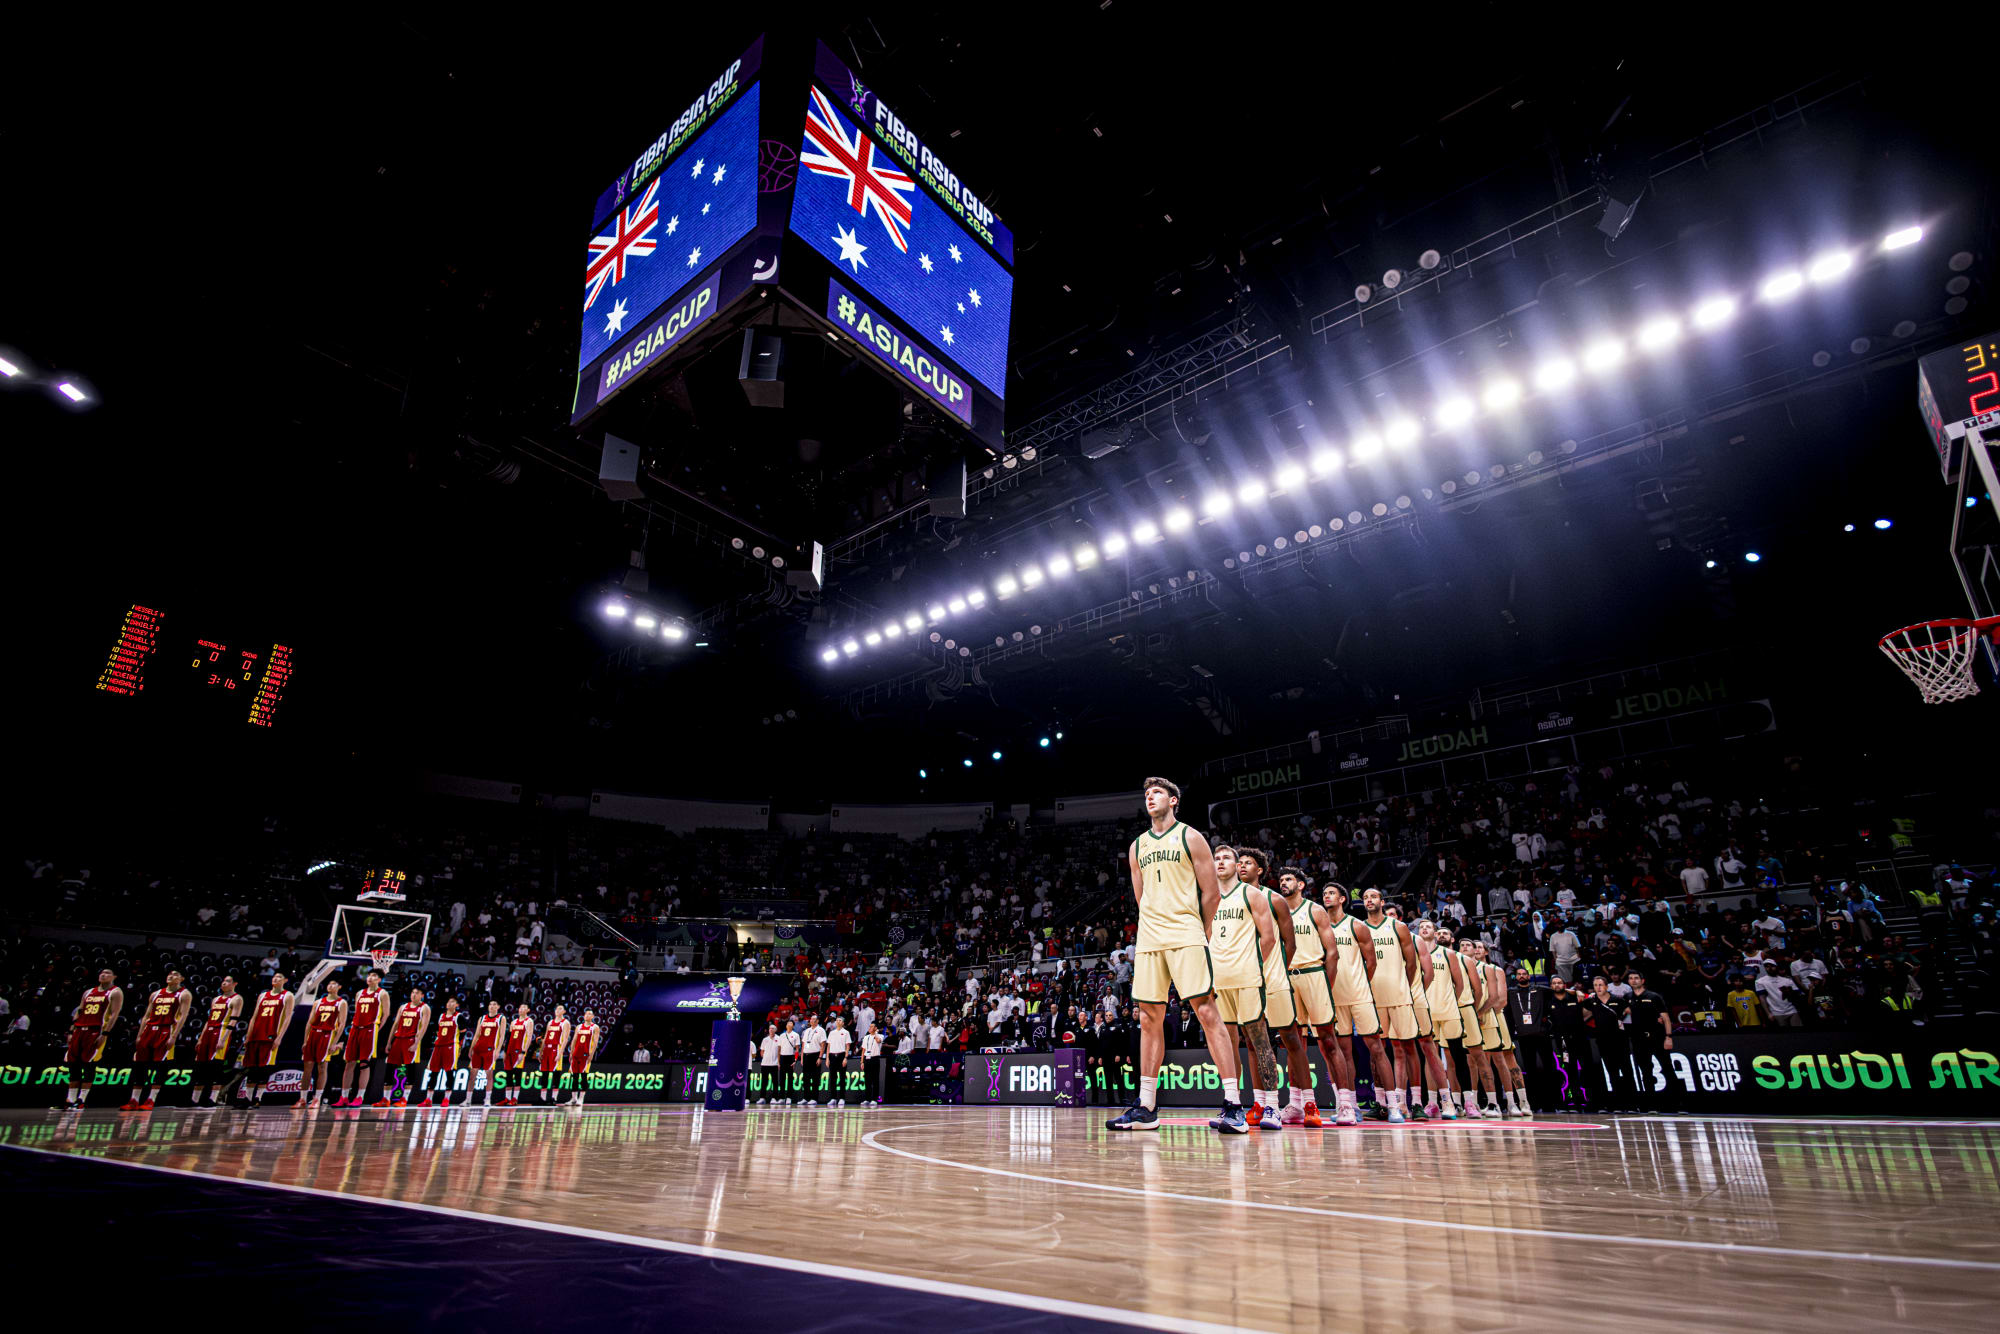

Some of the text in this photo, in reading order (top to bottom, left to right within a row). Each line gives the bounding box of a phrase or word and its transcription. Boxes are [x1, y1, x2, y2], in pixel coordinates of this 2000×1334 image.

[633, 59, 741, 179] FIBA ASIA CUP
[631, 80, 738, 192] SAUDI ARABIA 2025
[875, 99, 993, 227] FIBA ASIA CUP
[875, 122, 994, 245] SAUDI ARABIA 2025
[605, 287, 711, 388] #ASIACUP
[837, 294, 964, 403] #ASIACUP
[198, 640, 226, 651] AUSTRALIA
[209, 651, 220, 662] 0
[242, 651, 258, 660] CHINA
[192, 659, 200, 668] 0
[242, 660, 252, 670] 0
[208, 674, 236, 690] 3:16
[244, 672, 252, 680] 0
[1609, 676, 1728, 720] JEDDAH
[1558, 716, 1574, 727] CUP
[1397, 725, 1489, 762] JEDDAH
[1356, 757, 1369, 766] CUP
[1226, 763, 1302, 794] JEDDAH
[1139, 849, 1181, 870] AUSTRALIA
[384, 869, 406, 880] 3:16
[1157, 870, 1162, 882] 1
[378, 880, 400, 894] 24
[1214, 908, 1244, 920] STRALIA
[1220, 926, 1226, 938] 2
[1374, 938, 1394, 946] TRALIA
[84, 1004, 100, 1014] 39
[154, 1005, 170, 1016] 35
[262, 1007, 274, 1016] 21
[360, 1004, 369, 1014] 11
[320, 1013, 330, 1022] 17
[403, 1018, 412, 1026] 10
[1696, 1054, 1739, 1071] ASIA
[36, 1066, 132, 1085] ARBIA
[144, 1069, 193, 1086] 25
[1156, 1062, 1244, 1090] ARAB
[1752, 1050, 1912, 1090] SAUDI
[494, 1070, 553, 1090] SUDI
[558, 1071, 622, 1090] AABIA
[624, 1073, 664, 1090] 2025
[696, 1072, 708, 1092] FI
[1009, 1064, 1052, 1092] FIBA
[1700, 1072, 1741, 1092] CUP
[266, 1080, 314, 1092] Gante
